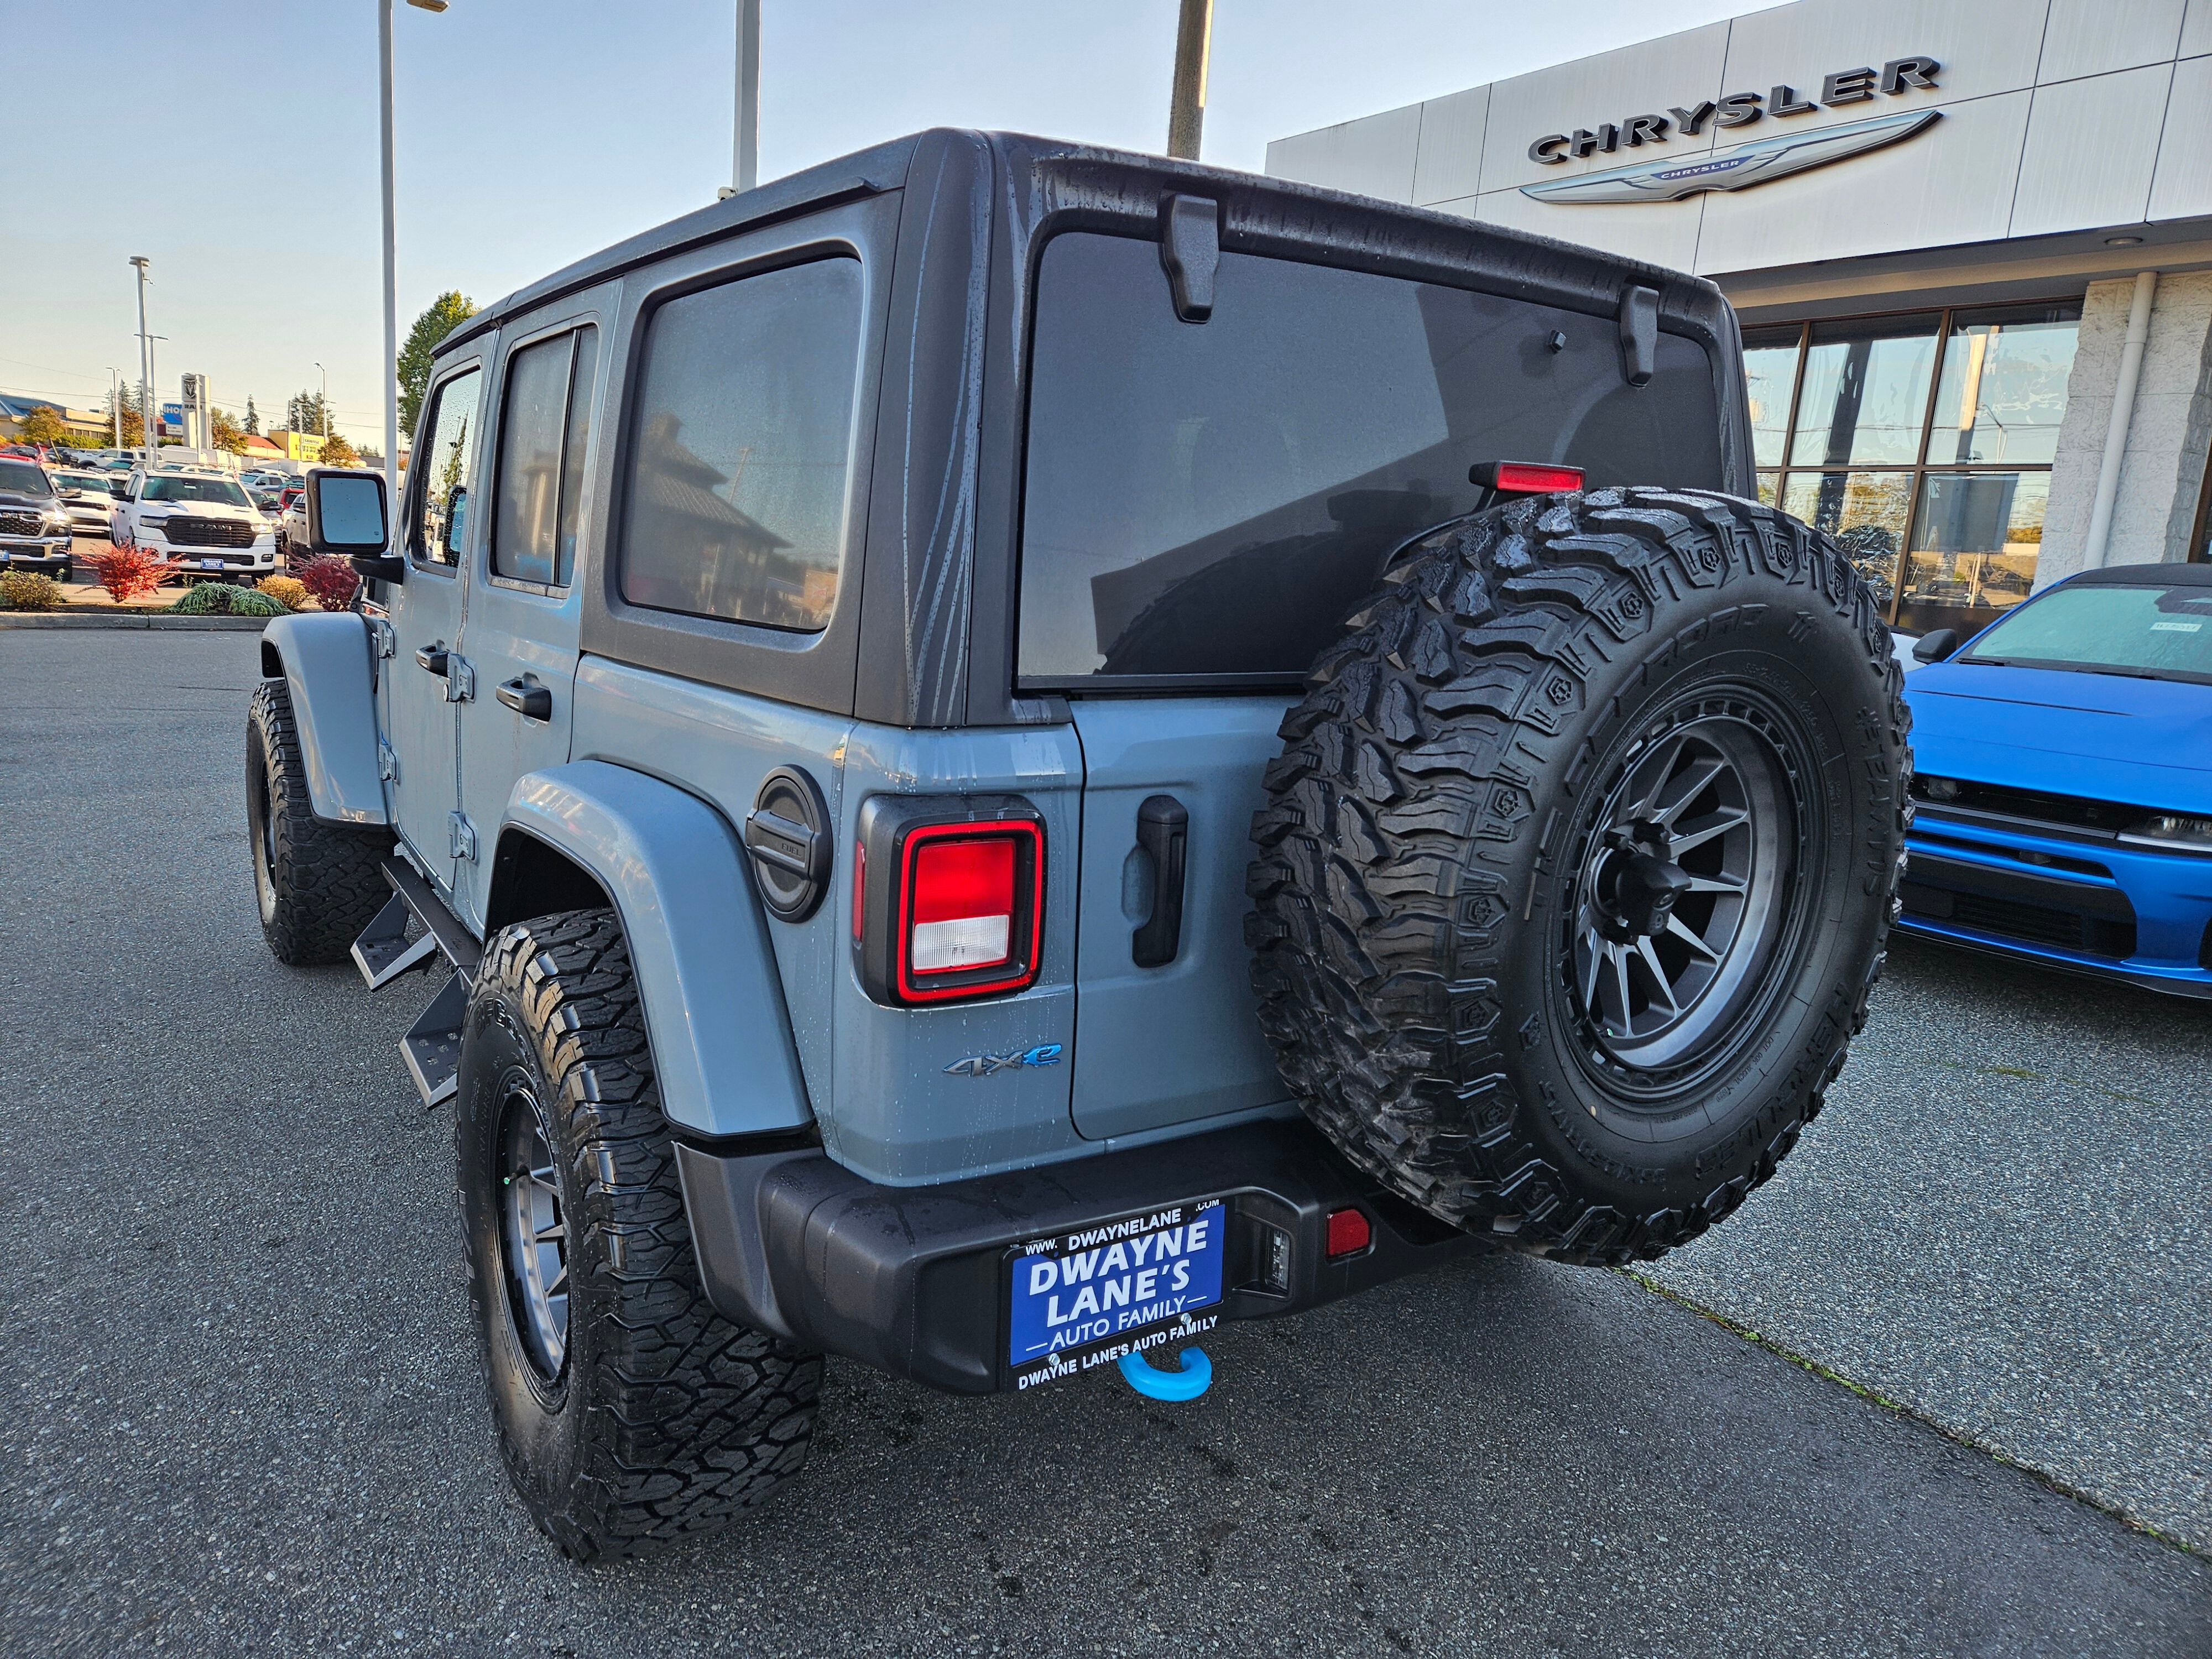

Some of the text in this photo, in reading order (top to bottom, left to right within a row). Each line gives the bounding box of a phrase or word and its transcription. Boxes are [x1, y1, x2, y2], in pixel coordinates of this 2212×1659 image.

[1528, 56, 1939, 165] CHRYSLER
[1661, 160, 1740, 180] CHRYSLER
[163, 405, 182, 418] IHO
[781, 843, 801, 858] FUEL
[1025, 1239, 1058, 1256] WWW.
[1068, 1208, 1181, 1251] DWAYNELANE
[1029, 1220, 1209, 1296] DWAYNE
[1047, 1259, 1190, 1327] LANE'S
[1049, 1295, 1186, 1351] AUTO FAMILY
[1018, 1315, 1218, 1390] DWAYNE LANE'S AUTO FAMILY
